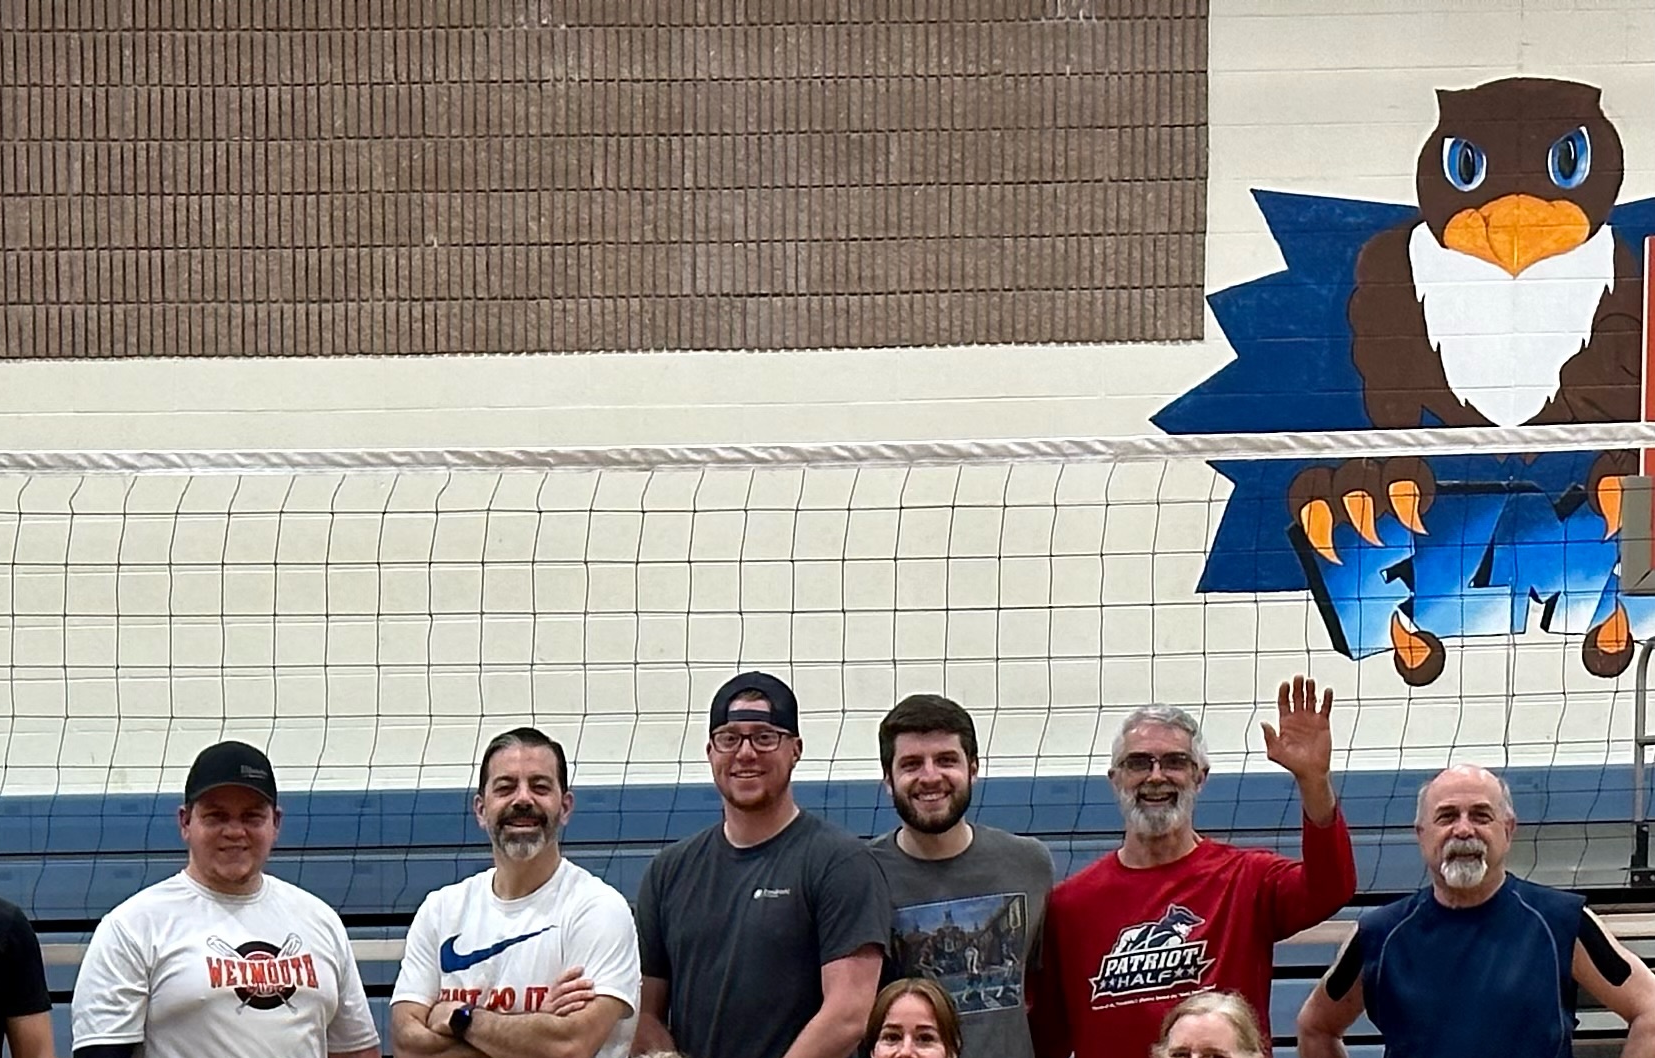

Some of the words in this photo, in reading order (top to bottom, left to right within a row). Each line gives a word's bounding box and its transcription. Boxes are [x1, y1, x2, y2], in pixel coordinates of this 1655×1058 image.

[206, 953, 320, 989] WEYMOUTH
[1104, 946, 1201, 978] PATRIOT
[1116, 970, 1173, 989] HALF
[487, 986, 516, 1012] DO
[524, 986, 549, 1012] IT
